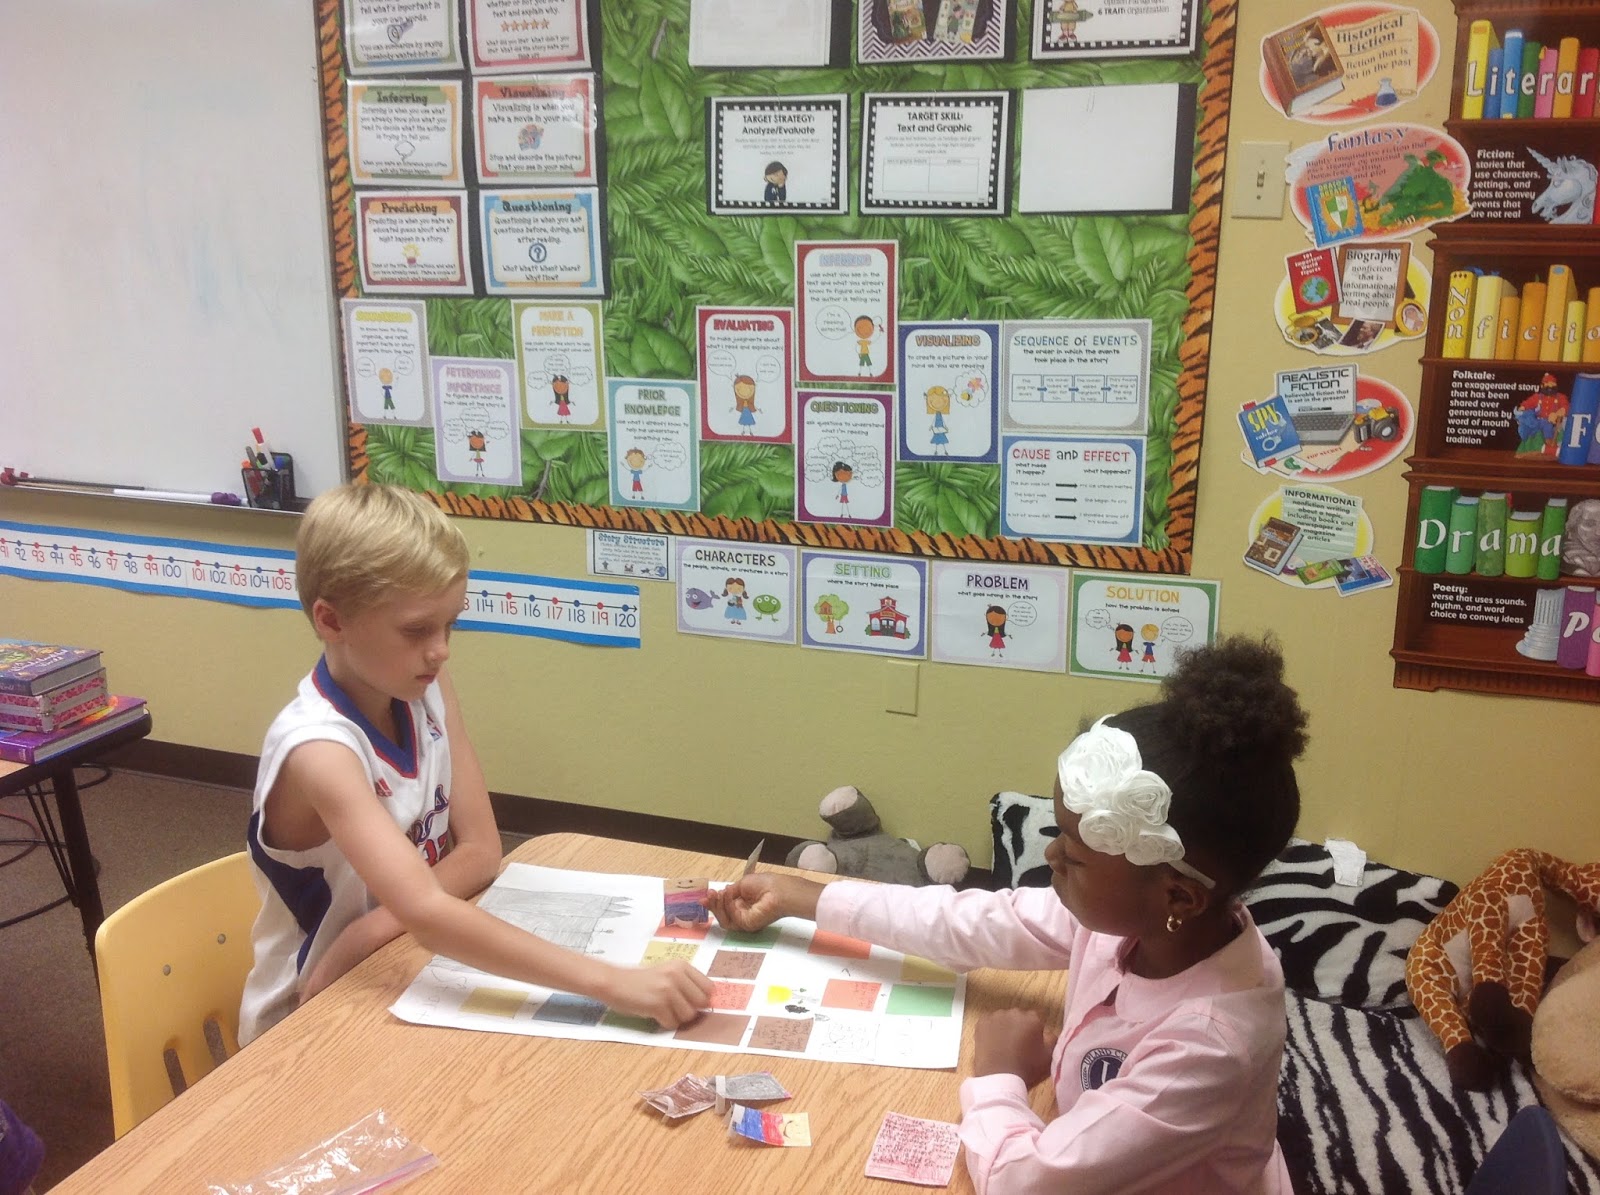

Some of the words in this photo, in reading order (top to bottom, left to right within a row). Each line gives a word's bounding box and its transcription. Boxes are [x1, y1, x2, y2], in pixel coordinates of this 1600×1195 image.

[1337, 16, 1403, 43] Historical
[1349, 32, 1395, 53] Fiction
[1347, 56, 1376, 69] fiction
[1379, 48, 1397, 59] that
[1346, 72, 1359, 80] set
[1362, 69, 1371, 77] in
[1374, 62, 1389, 73] the
[1391, 59, 1411, 70] past
[1467, 61, 1600, 97] Literar
[377, 91, 428, 107] Inferring
[743, 114, 772, 123] TARGET
[774, 114, 815, 123] STRATEGY:
[908, 112, 938, 120] TARGET
[940, 112, 964, 120] SKILL:
[742, 126, 815, 136] Analyze/Evaluate
[897, 124, 916, 133] Text
[917, 124, 935, 132] and
[936, 124, 972, 134] Graphic
[1328, 127, 1409, 152] Fantasy
[1477, 149, 1515, 159] Fiction:
[1475, 161, 1505, 169] stories
[1507, 161, 1525, 169] that
[1475, 171, 1490, 179] use
[1492, 170, 1541, 179] characters,
[1473, 181, 1511, 190] settings,
[1513, 180, 1531, 188] and
[1472, 191, 1493, 199] plots
[1495, 191, 1503, 199] to
[1505, 191, 1536, 200] convey
[381, 202, 437, 216] Predicting
[502, 200, 572, 214] Questioning
[1503, 200, 1521, 208] that
[1487, 210, 1502, 218] not
[1504, 210, 1521, 218] real
[1347, 250, 1400, 264] Biography
[1352, 265, 1392, 273] nonfiction
[1358, 273, 1374, 281] that
[1343, 282, 1396, 290] informational
[1343, 291, 1370, 299] writing
[1362, 300, 1390, 308] people
[713, 319, 774, 331] EVALUATING
[915, 335, 981, 347] VISUALIZING
[1013, 335, 1069, 346] SEQUENCE
[1093, 335, 1138, 346] EVENTS
[1282, 369, 1349, 383] REALISTIC
[1453, 370, 1495, 380] Folktale:
[1291, 379, 1340, 392] FICTION
[1464, 383, 1516, 391] exaggerated
[1518, 384, 1540, 392] story
[638, 389, 666, 401] PRIOR
[1450, 390, 1468, 398] that
[624, 403, 681, 416] KNOWLEDGE
[810, 400, 879, 414] QUESTIONING
[1450, 399, 1479, 408] shared
[1247, 403, 1280, 433] SPY
[1449, 409, 1499, 418] generations
[1501, 410, 1512, 419] by
[1448, 418, 1469, 426] word
[1457, 429, 1488, 437] convey
[1446, 436, 1482, 444] tradition
[1013, 449, 1051, 460] CAUSE
[1084, 450, 1130, 462] EFFECT
[1285, 489, 1357, 507] INFORMATIONAL
[1417, 519, 1562, 557] Drama
[695, 550, 776, 567] CHARACTERS
[15, 547, 27, 561] 92
[32, 550, 45, 562] 93
[50, 551, 64, 564] 94
[69, 553, 83, 566] 95
[88, 555, 101, 569] 96
[106, 557, 118, 570] 97
[124, 560, 138, 574] 98
[144, 562, 159, 575] 99
[161, 563, 182, 578] 100
[192, 567, 206, 581] 101
[209, 570, 226, 584] 102
[230, 573, 247, 586] 103
[250, 574, 270, 588] 104
[272, 576, 292, 590] 105
[835, 563, 891, 579] SETTING
[967, 575, 1029, 590] PROBLEM
[1433, 583, 1468, 594] Poetry:
[1106, 585, 1180, 603] SOLUTION
[1431, 602, 1463, 611] rhythm,
[1465, 604, 1482, 612] and
[1484, 606, 1505, 614] word
[1495, 598, 1527, 607] sounds,
[477, 599, 494, 613] 114
[501, 601, 518, 615] 115
[524, 603, 541, 617] 116
[547, 606, 563, 620] 117
[568, 608, 586, 623] 118
[592, 611, 609, 626] 119
[614, 613, 636, 628] 120
[1430, 610, 1457, 619] choice
[1469, 614, 1500, 624] convey
[1501, 615, 1524, 624] ideas
